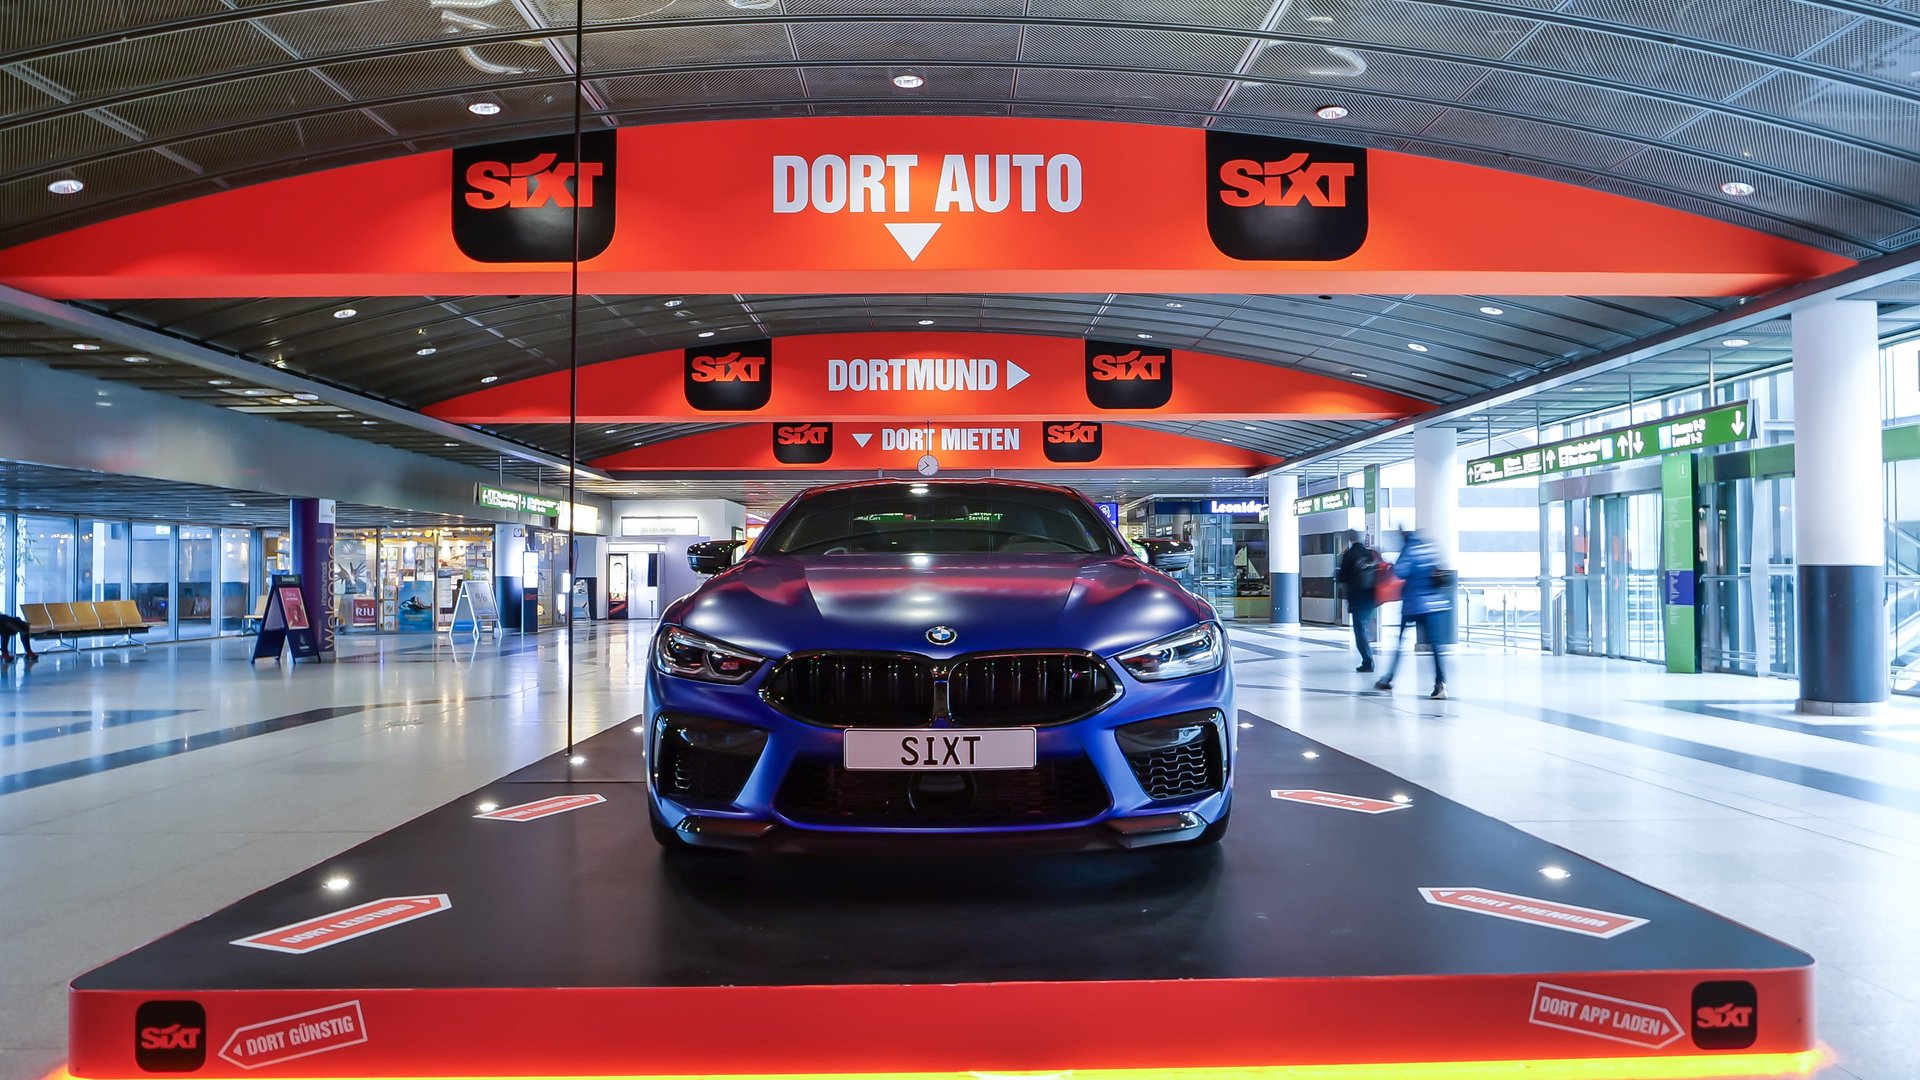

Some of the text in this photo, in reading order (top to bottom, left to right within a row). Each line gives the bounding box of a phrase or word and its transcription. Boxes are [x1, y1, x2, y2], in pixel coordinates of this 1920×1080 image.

[465, 153, 603, 210] SIXT
[773, 153, 1083, 214] DORT AUTO
[1219, 153, 1354, 208] SIXT
[691, 352, 765, 382] SIXT
[828, 358, 998, 392] DORTMUND
[1092, 351, 1165, 381] SIXT
[777, 424, 828, 445] SIXT
[881, 428, 1020, 451] DORT MIETEN
[1047, 422, 1098, 444] SIXT
[1211, 500, 1268, 513] Leonida
[355, 607, 375, 617] RIU
[900, 736, 982, 766] SIXT
[1458, 894, 1609, 927] DORT PREMIUM
[1539, 995, 1661, 1036] DORT APP LADEN
[1696, 1003, 1752, 1028] SIXT
[141, 1023, 200, 1049] SIXT
[246, 1015, 355, 1056] DORT GÜNSTIG
